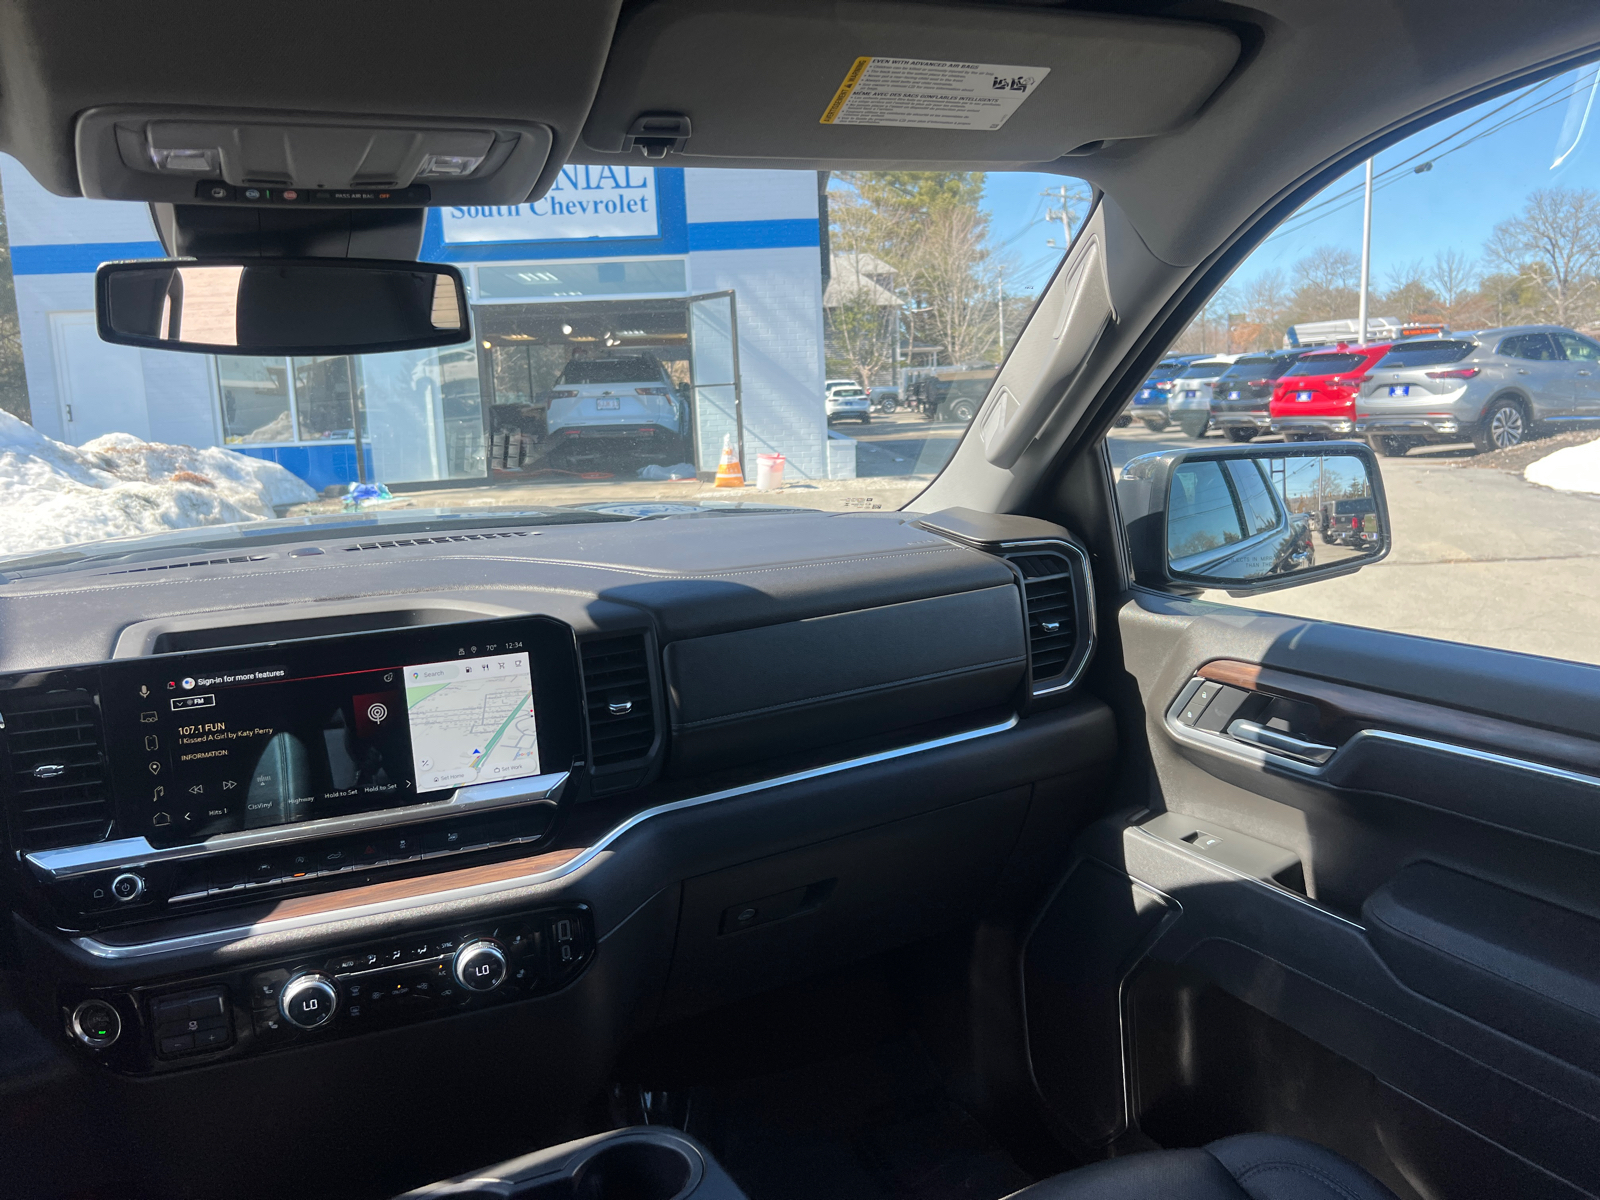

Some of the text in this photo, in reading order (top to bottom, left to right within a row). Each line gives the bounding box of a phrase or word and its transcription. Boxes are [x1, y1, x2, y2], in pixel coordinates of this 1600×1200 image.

[848, 60, 867, 82] WARNING
[530, 194, 649, 216] Chevrolet
[198, 676, 222, 686] Sign-in
[236, 673, 254, 681] more
[256, 669, 284, 678] features
[178, 722, 225, 735] 107.1 FUN
[238, 730, 253, 738] Katy
[255, 727, 273, 735] Perry
[181, 750, 228, 761] INFORMATION
